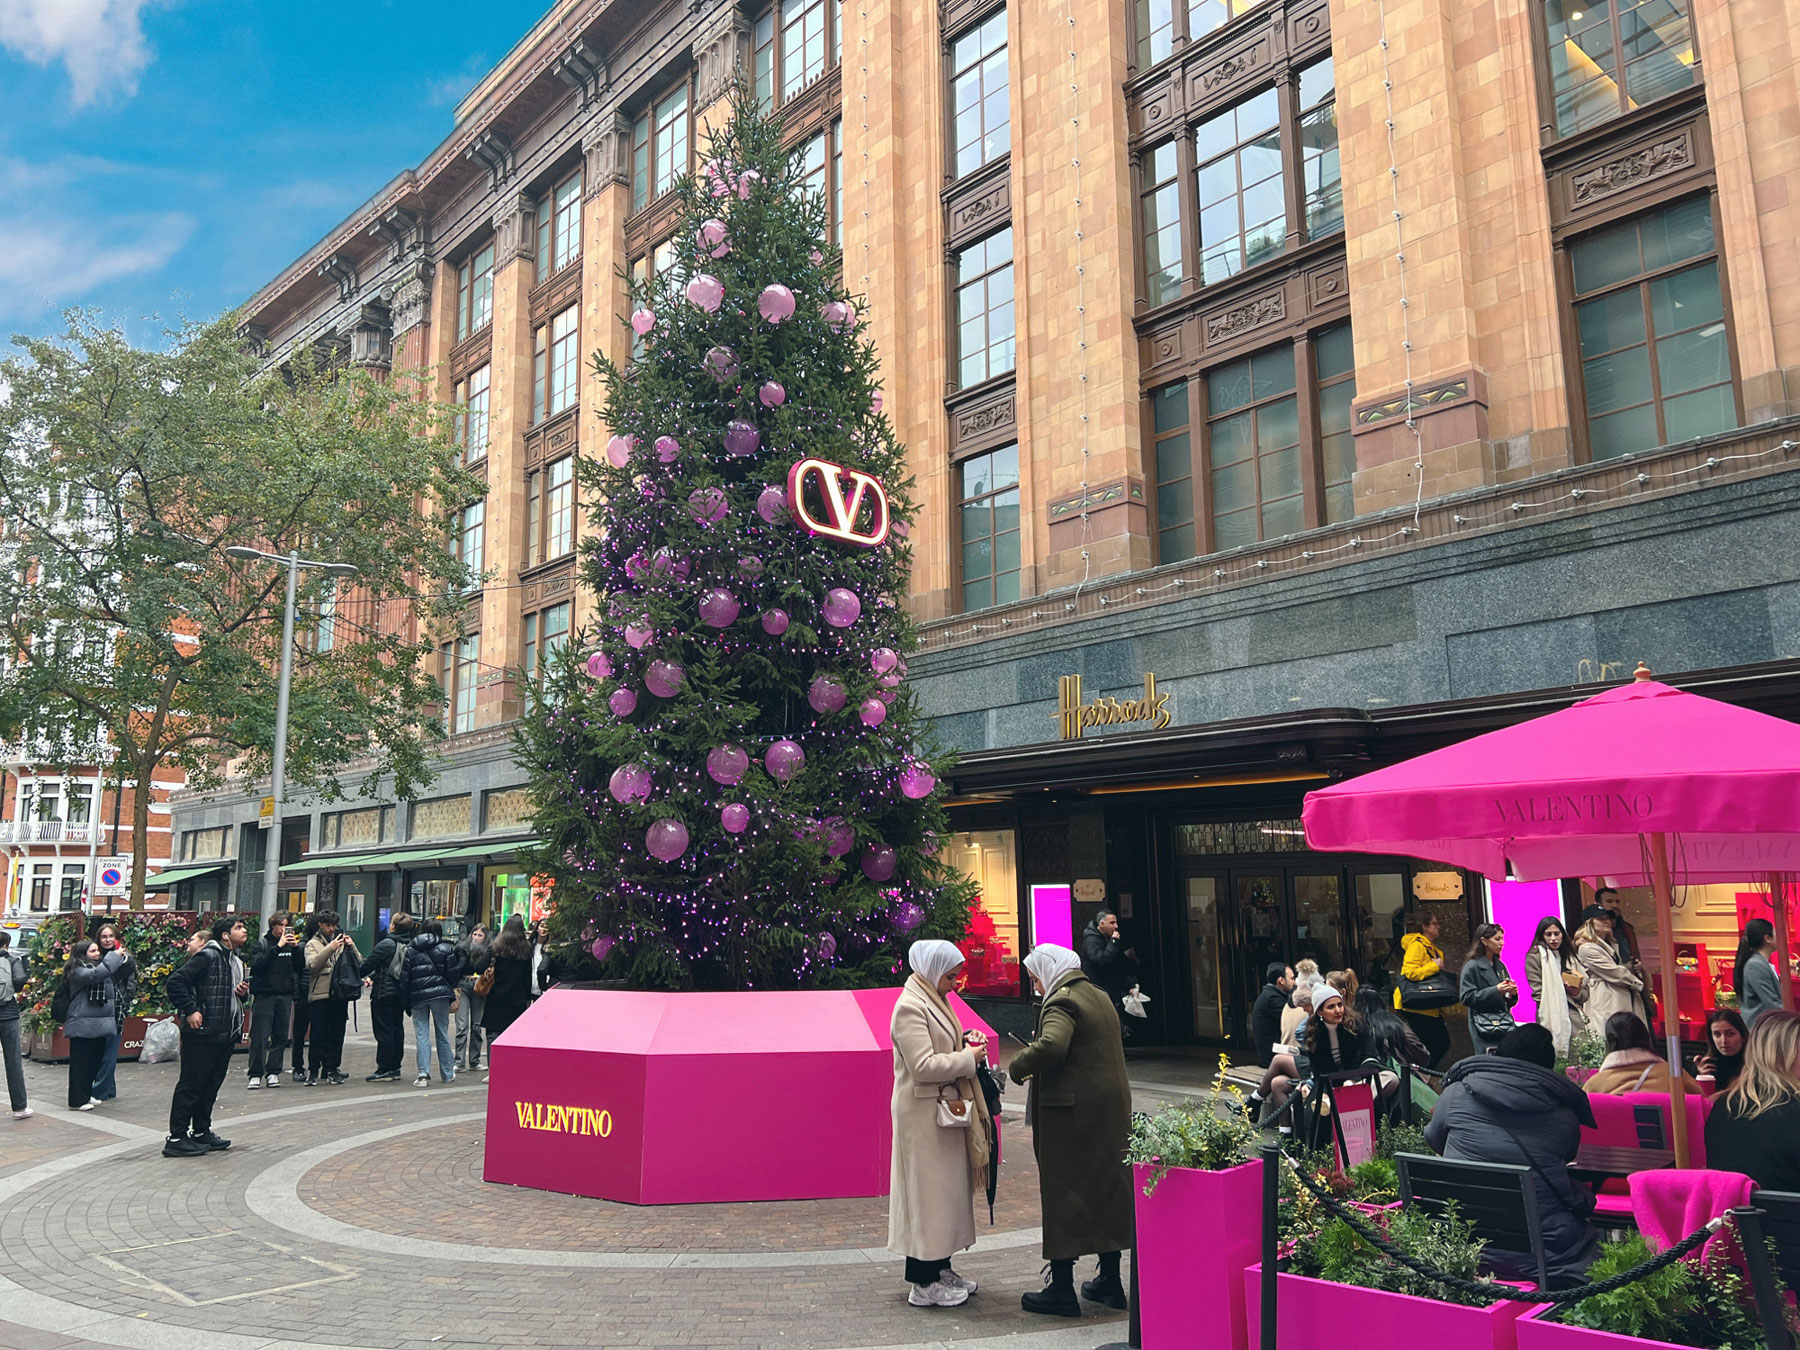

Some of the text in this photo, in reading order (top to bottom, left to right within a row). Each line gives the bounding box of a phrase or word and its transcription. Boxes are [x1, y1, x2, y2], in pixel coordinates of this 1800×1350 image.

[1047, 672, 1171, 740] Harrods
[1494, 792, 1654, 823] VALENTINO
[124, 1040, 145, 1049] CRAZ
[514, 1100, 613, 1138] VALENTINO
